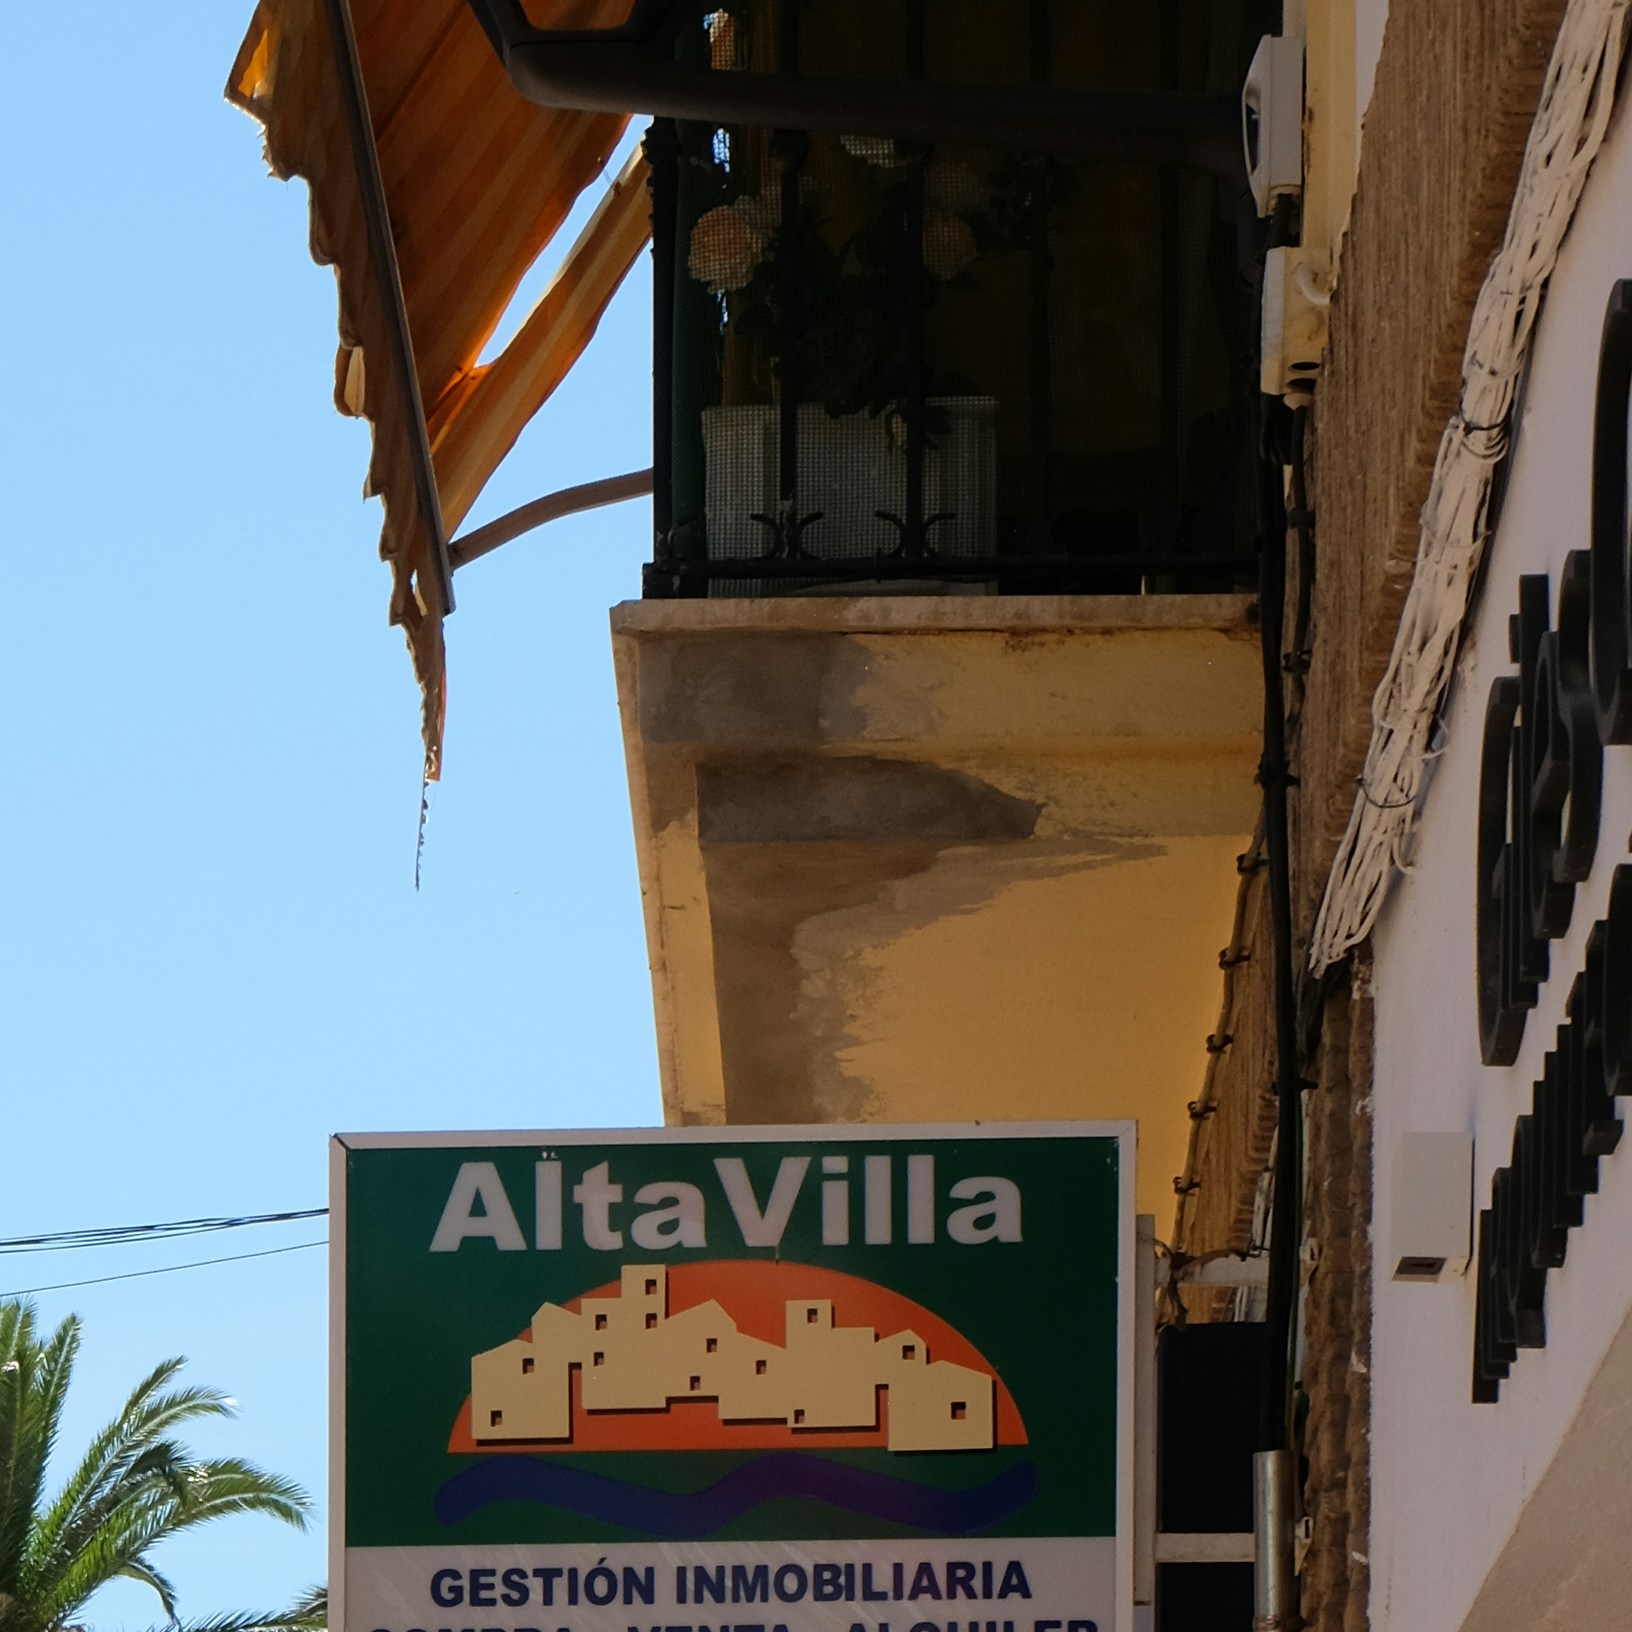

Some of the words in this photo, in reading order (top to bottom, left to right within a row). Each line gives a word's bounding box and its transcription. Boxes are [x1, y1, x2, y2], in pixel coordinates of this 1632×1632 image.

[429, 1153, 1024, 1253] AltaVilla
[430, 1556, 656, 1609] GESTIÓN
[677, 1560, 1032, 1606] INMOBILIARIA
